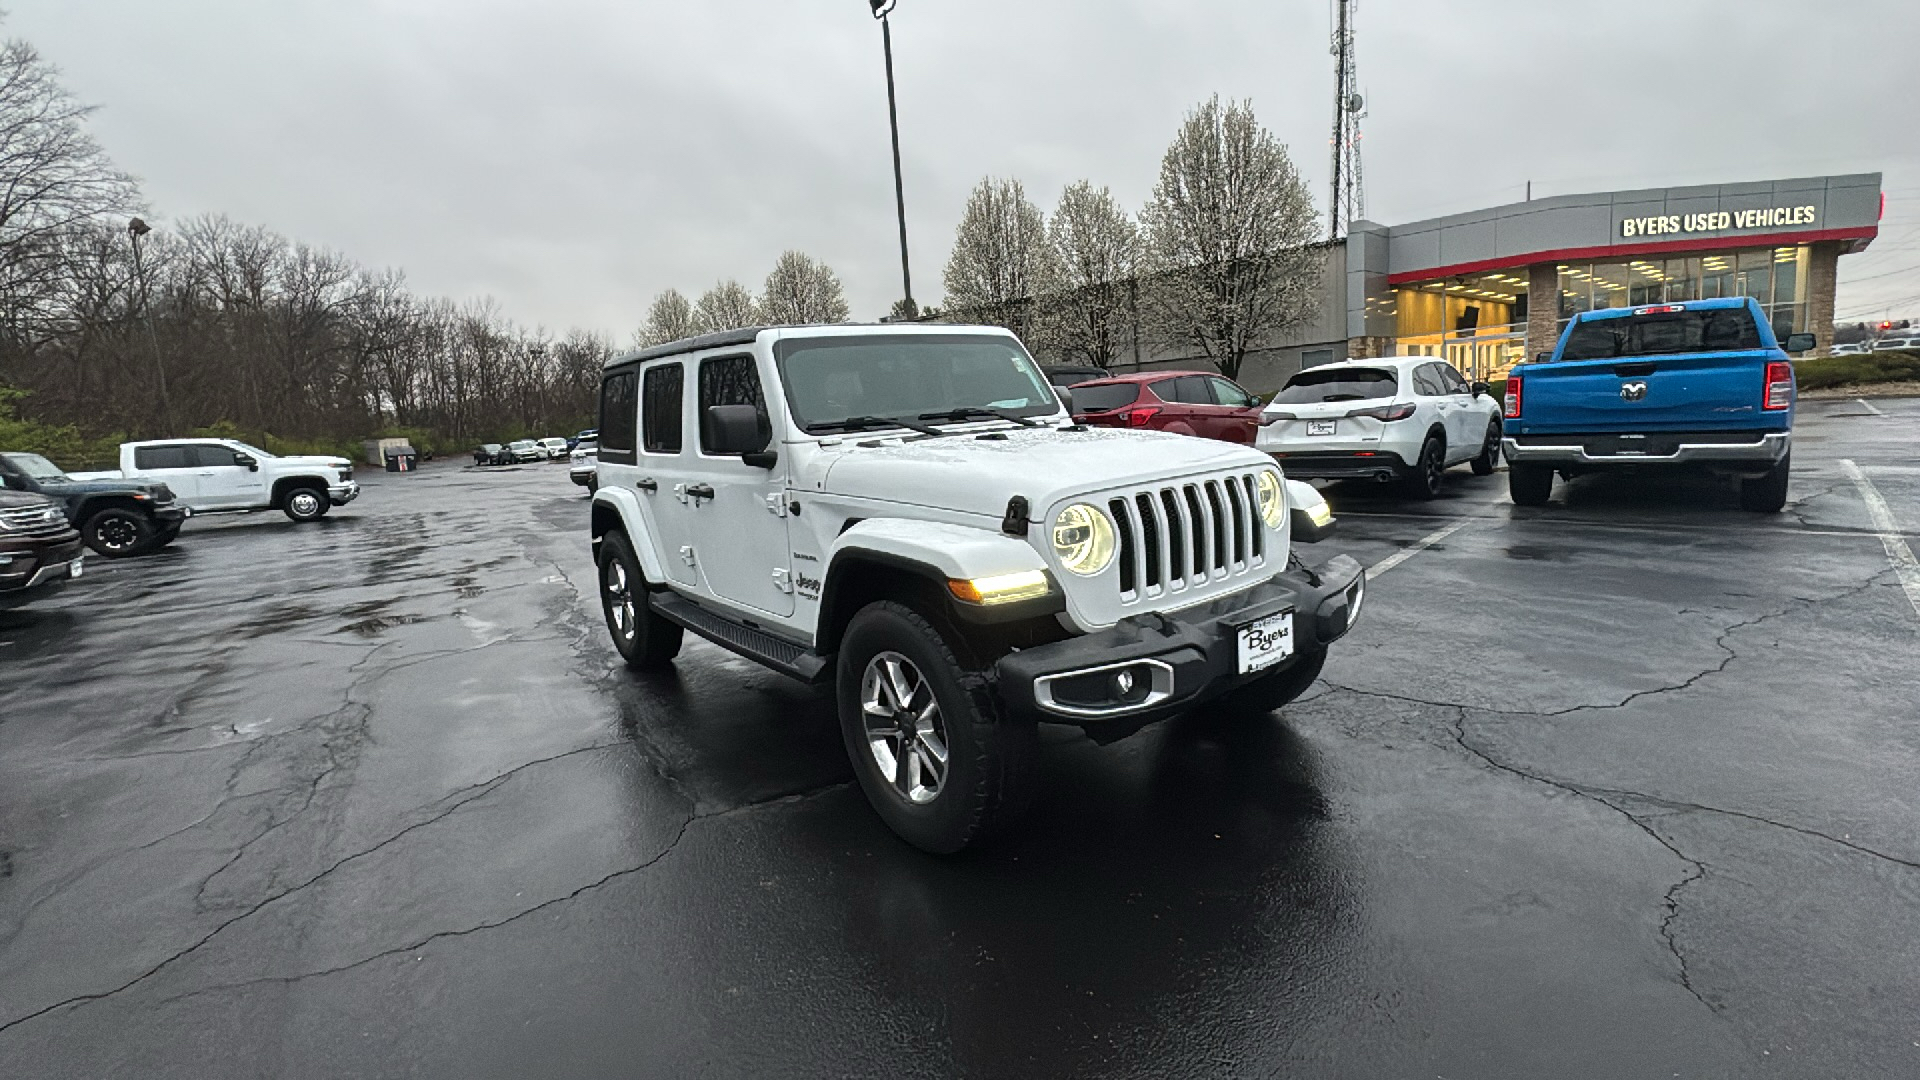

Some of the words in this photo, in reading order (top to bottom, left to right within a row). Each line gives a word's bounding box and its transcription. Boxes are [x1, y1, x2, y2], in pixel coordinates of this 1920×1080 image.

[1621, 215, 1680, 237] BYERS
[1683, 212, 1730, 232] USED
[1733, 206, 1815, 229] VEHICLES
[1242, 627, 1289, 651] Byers
